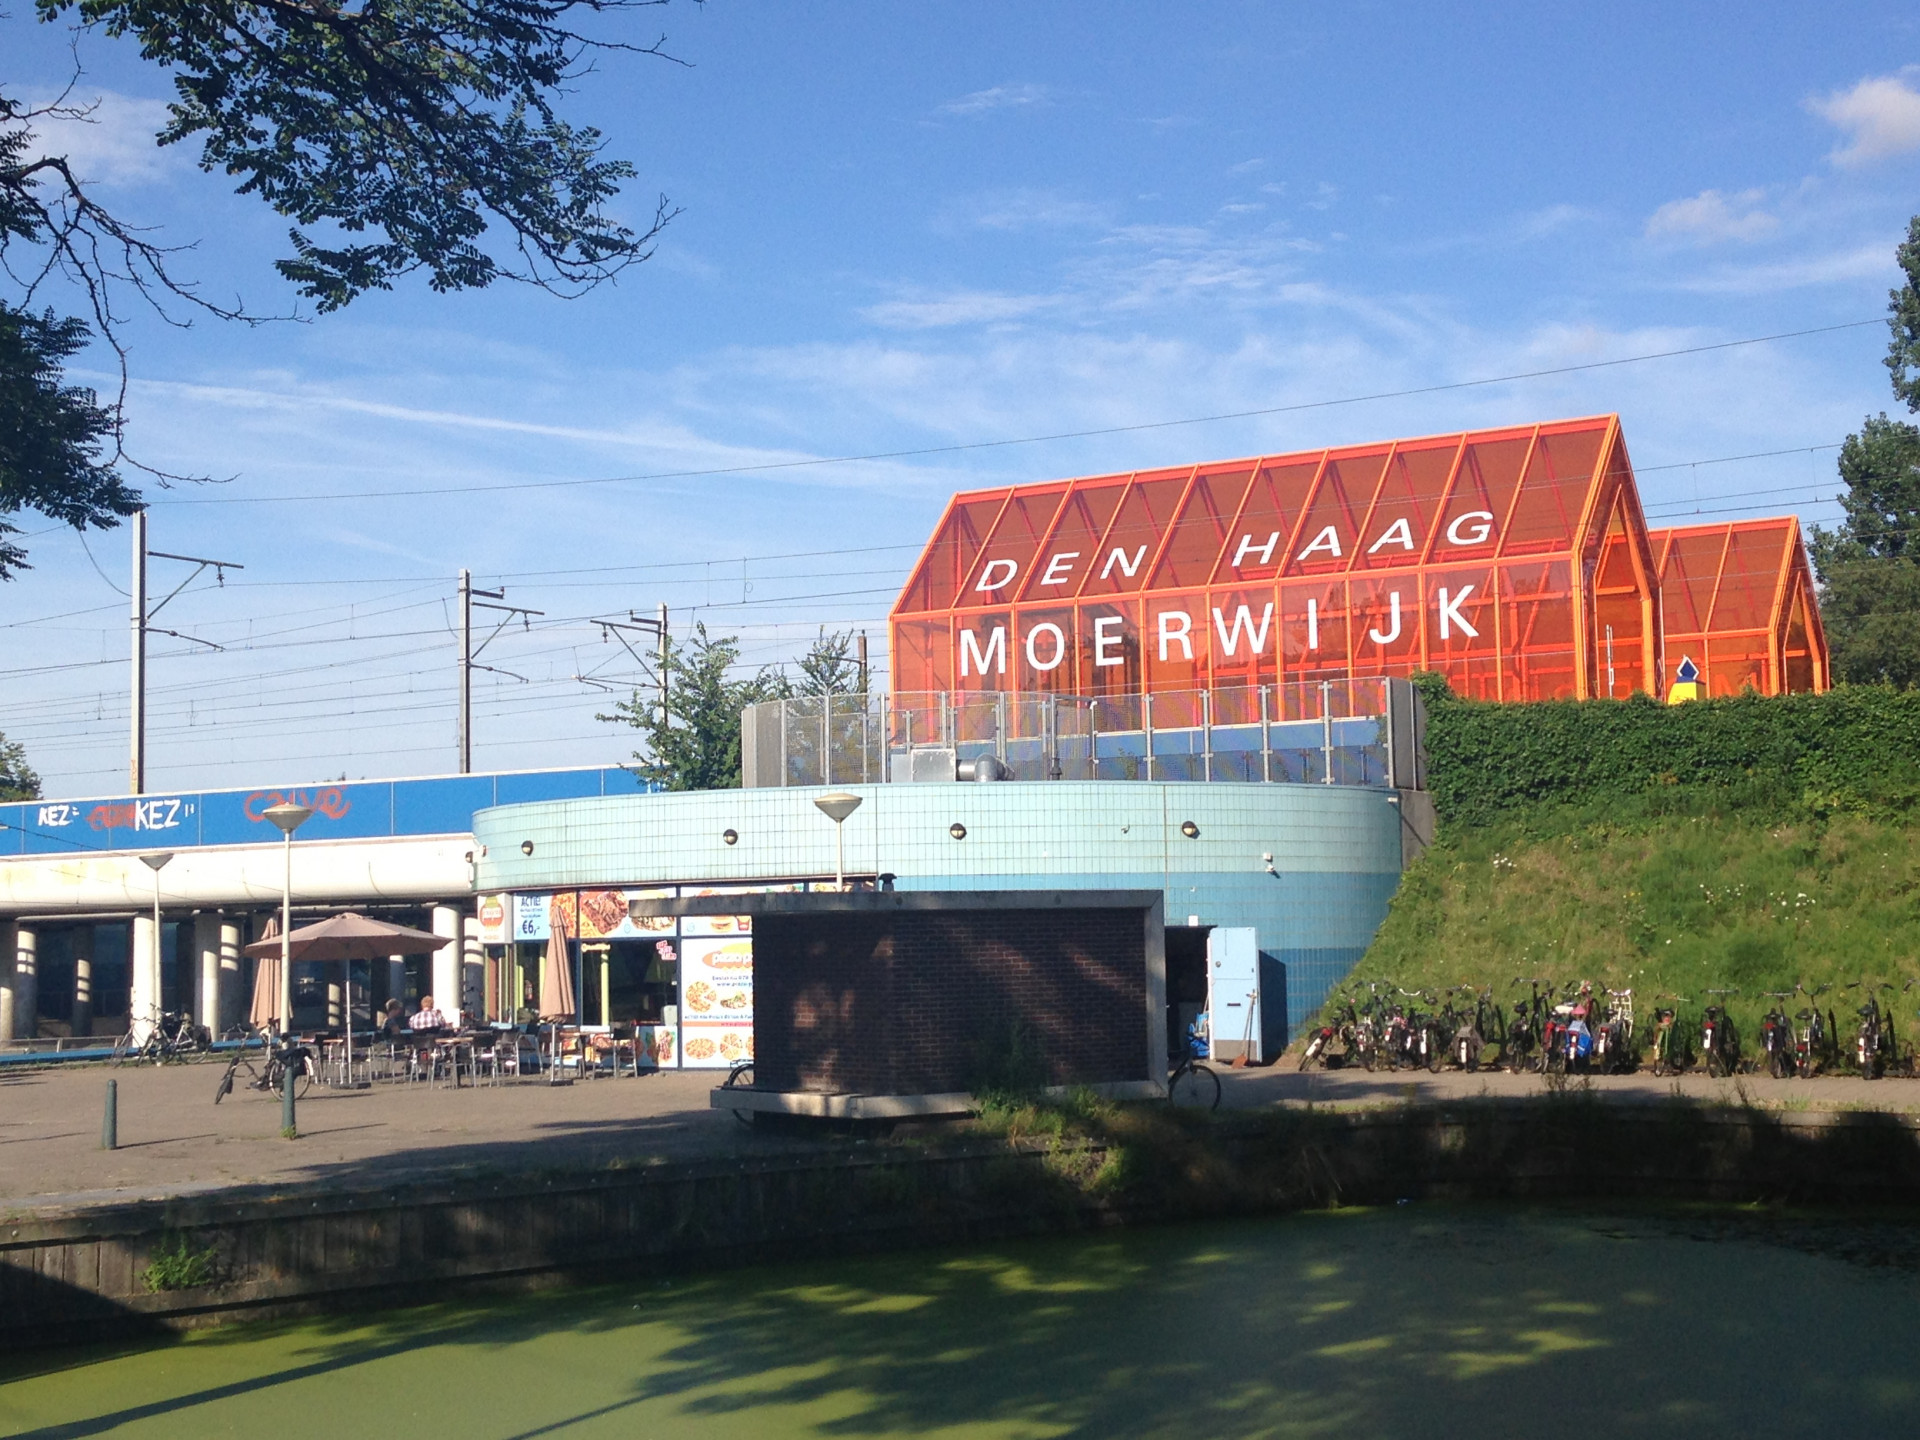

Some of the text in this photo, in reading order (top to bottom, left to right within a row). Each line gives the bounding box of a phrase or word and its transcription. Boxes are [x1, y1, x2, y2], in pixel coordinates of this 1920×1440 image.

[974, 510, 1494, 592] DEN HAAG
[960, 584, 1479, 677] MOERWIJK
